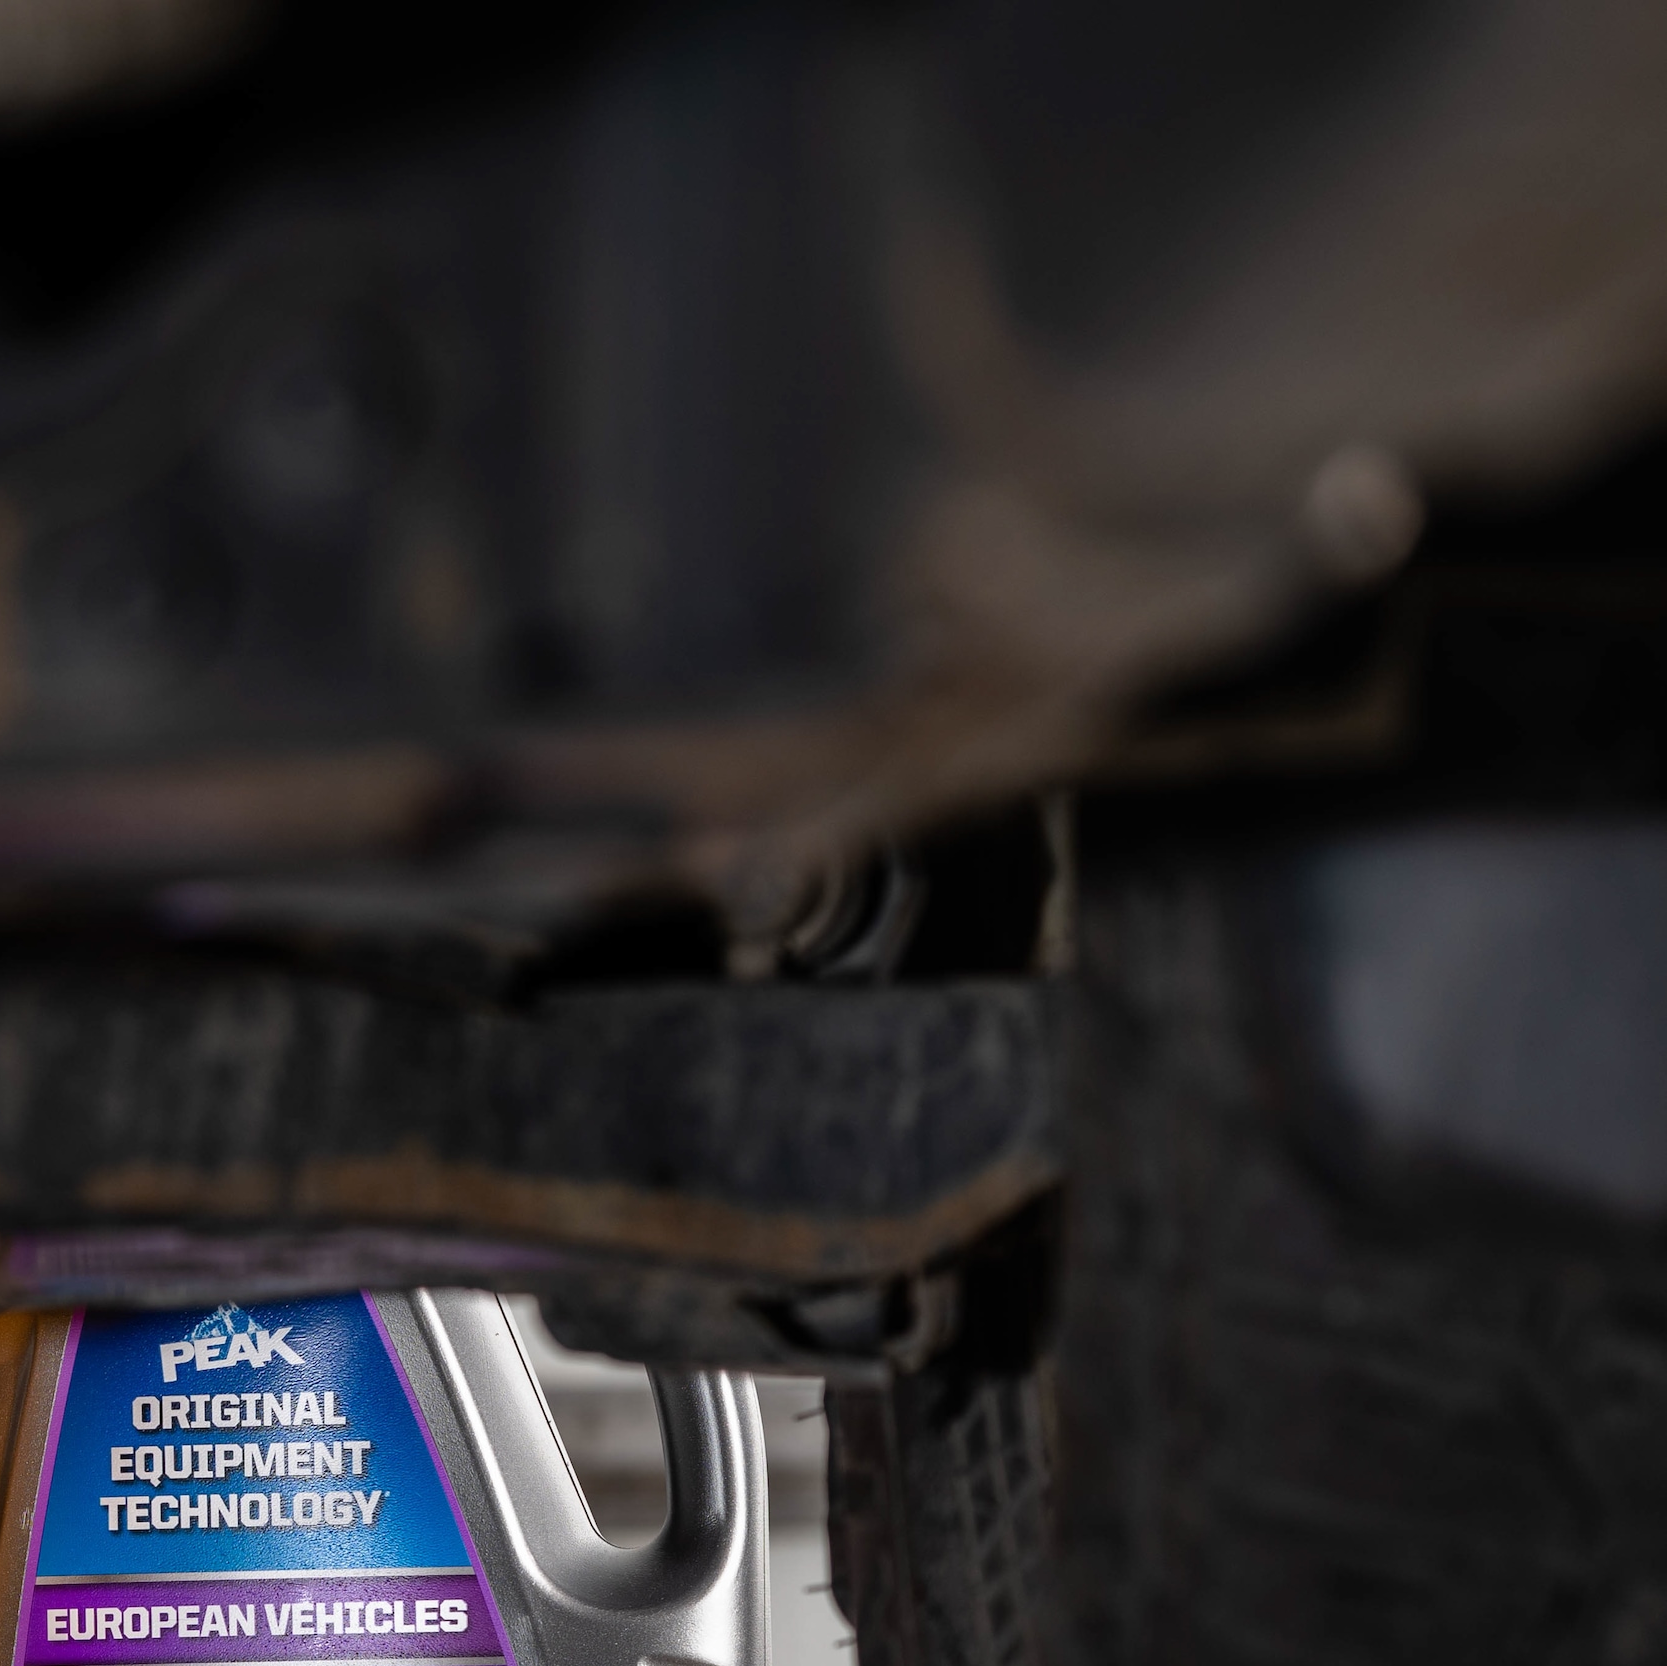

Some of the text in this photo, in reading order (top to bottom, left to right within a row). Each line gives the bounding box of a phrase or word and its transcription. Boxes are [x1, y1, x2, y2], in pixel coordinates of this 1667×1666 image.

[159, 1325, 305, 1383] PEAK
[131, 1390, 347, 1431] ORIGINAL
[110, 1440, 371, 1488] EQUIPMENT
[99, 1489, 383, 1531] TECHNOLOGY
[46, 1599, 468, 1642] EUROPEAN VEHICLES
